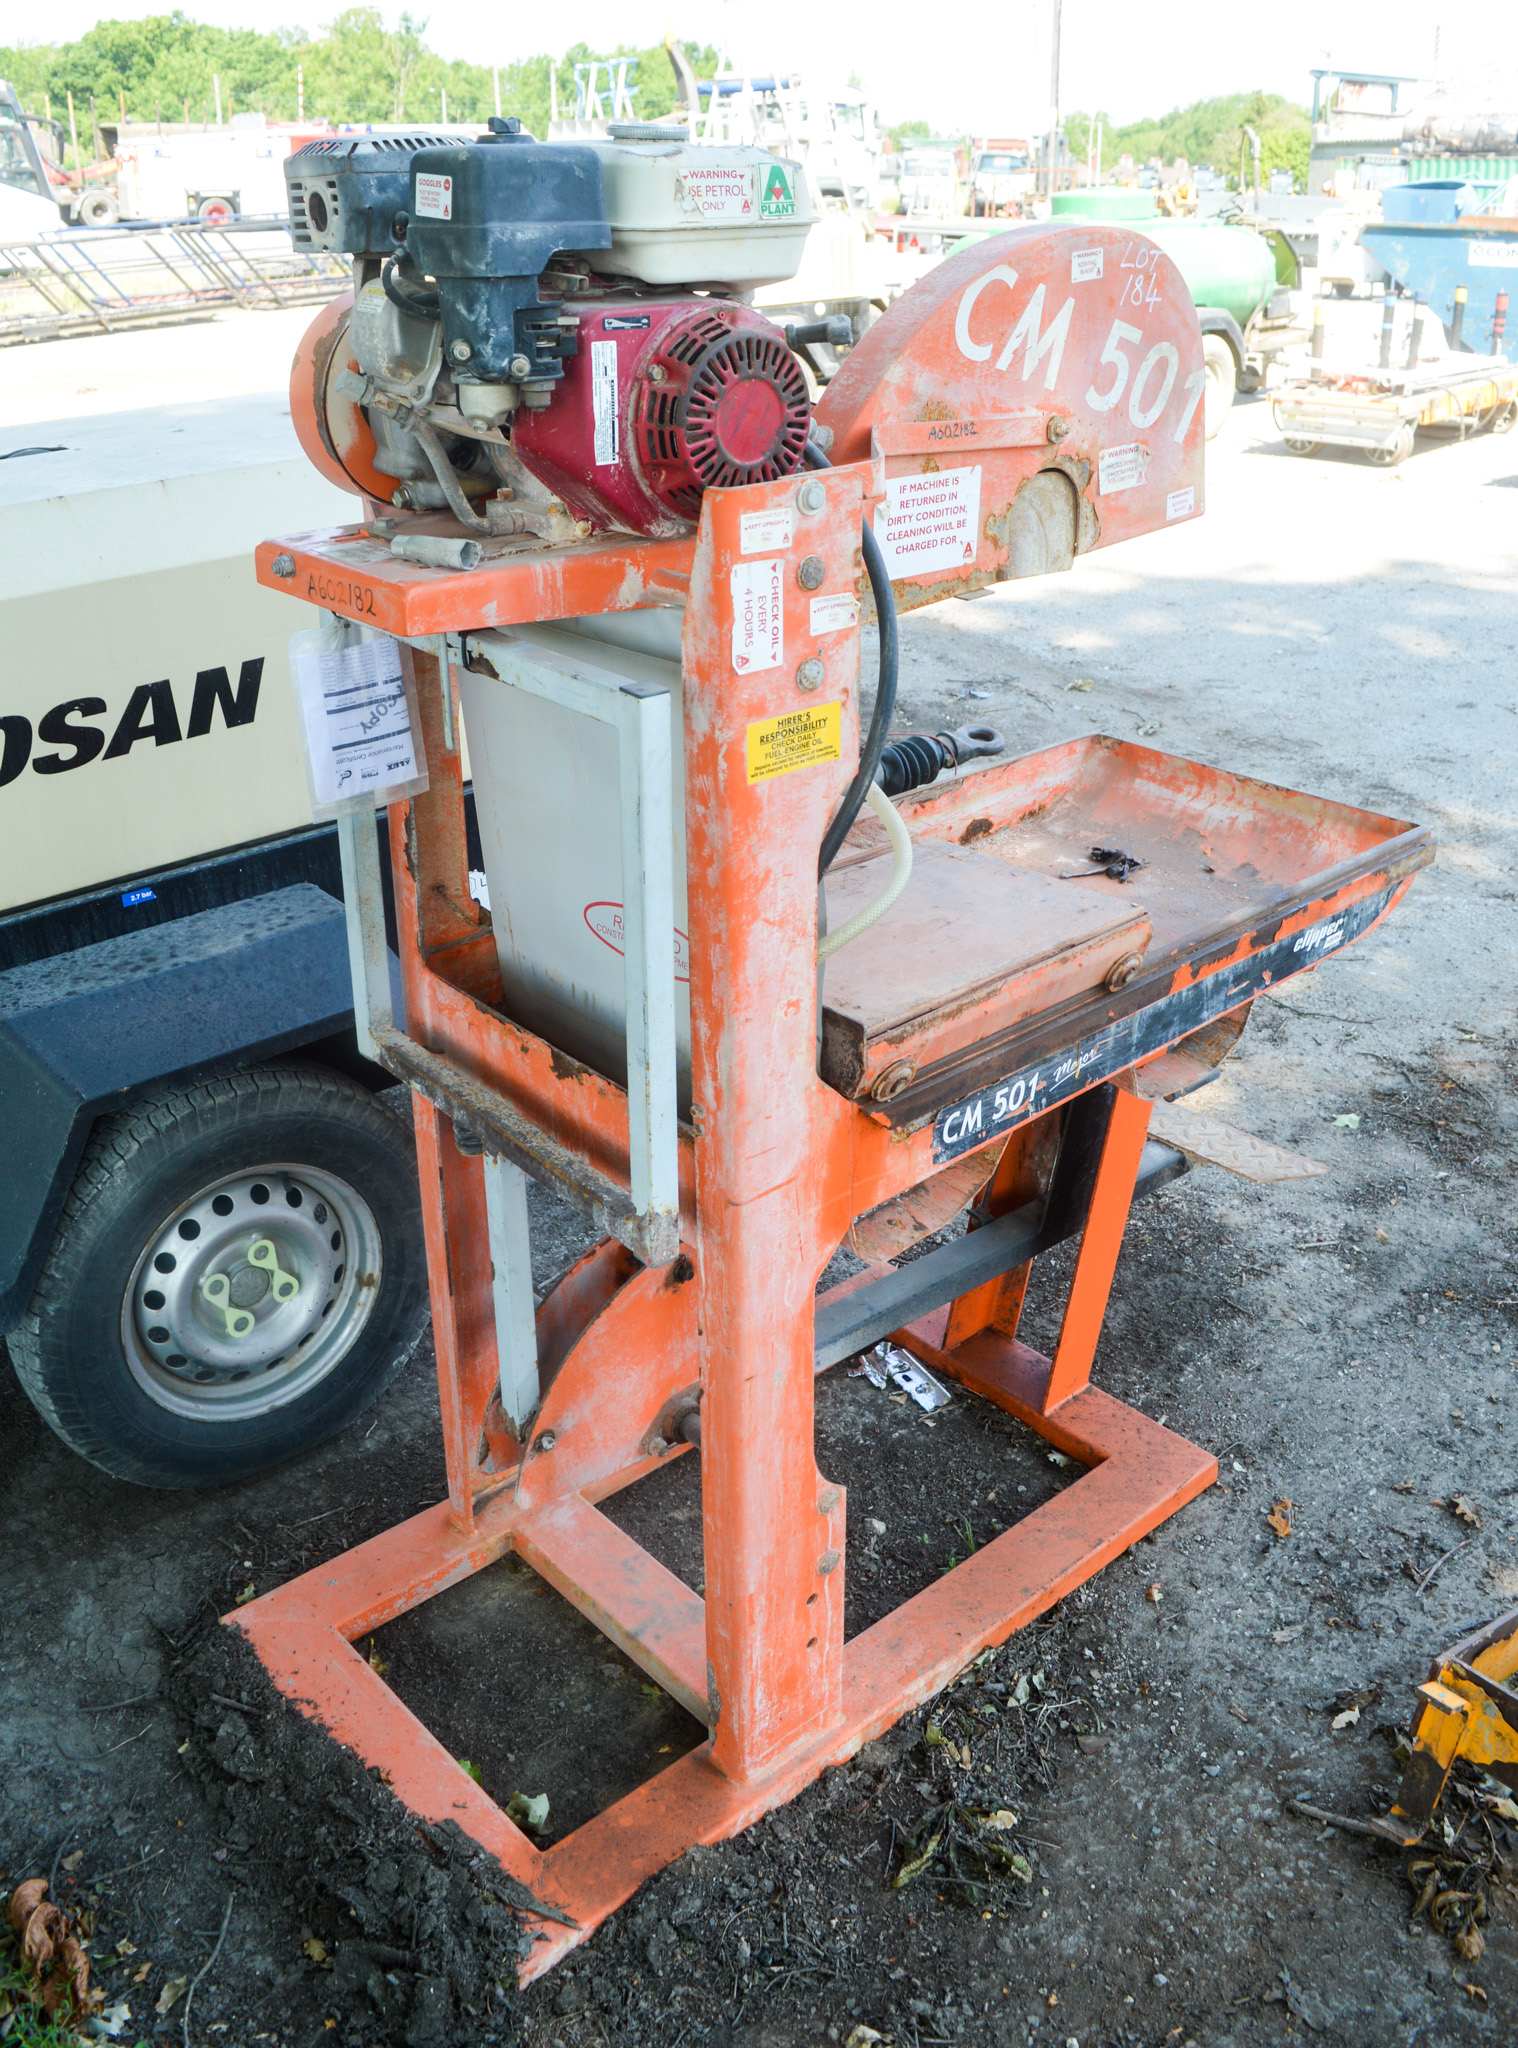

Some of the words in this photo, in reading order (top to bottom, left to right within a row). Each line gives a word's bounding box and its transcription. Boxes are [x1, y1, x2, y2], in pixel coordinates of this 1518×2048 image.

[418, 178, 442, 188] GOGGLES
[689, 170, 738, 179] WARNING
[763, 165, 793, 201] A
[705, 185, 747, 197] PETROL
[702, 201, 726, 211] ONLY
[761, 203, 796, 215] PLANT
[1077, 250, 1099, 259] WARNING
[1120, 240, 1165, 274] LOT
[1120, 272, 1162, 312] 184
[955, 264, 1076, 391] CM
[1085, 318, 1205, 444] 501
[927, 421, 979, 441] A602182
[1107, 445, 1140, 458] WARNING
[899, 485, 907, 494] IF
[909, 478, 950, 493] MACHINE
[952, 476, 959, 486] IS
[899, 493, 946, 509] RETURNED
[948, 491, 958, 501] IN
[762, 519, 785, 527] UPRIGHT
[887, 514, 914, 527] DIRTY
[915, 504, 968, 522] CONDITION,
[886, 525, 932, 542] CLEANING
[933, 522, 954, 533] WILL
[956, 519, 967, 529] BE
[895, 539, 938, 555] CHARGED
[940, 535, 957, 546] FOR
[308, 573, 376, 617] A602182
[744, 587, 753, 596] 4
[771, 575, 779, 623] CHECK
[744, 598, 754, 648] HOURS
[758, 595, 767, 634] EVERY
[771, 625, 779, 649] OIL
[360, 697, 397, 735] COPY
[777, 711, 811, 729] HIRER'S
[760, 717, 828, 744] RESPONSIBILITY
[772, 737, 795, 750] CHECK
[797, 731, 817, 743] DAILY
[335, 753, 366, 765] Certificate
[368, 744, 404, 758] Maintenance
[754, 763, 771, 771] Repairs
[816, 744, 833, 753] machine
[765, 741, 810, 760] FUEL-ENGINE
[812, 738, 823, 746] OIL
[130, 893, 140, 902] 2.7
[141, 890, 152, 899] bar
[1293, 917, 1344, 953] clipper
[942, 1099, 982, 1144] CM
[992, 1071, 1040, 1120] 501
[1053, 1045, 1099, 1083] Major
